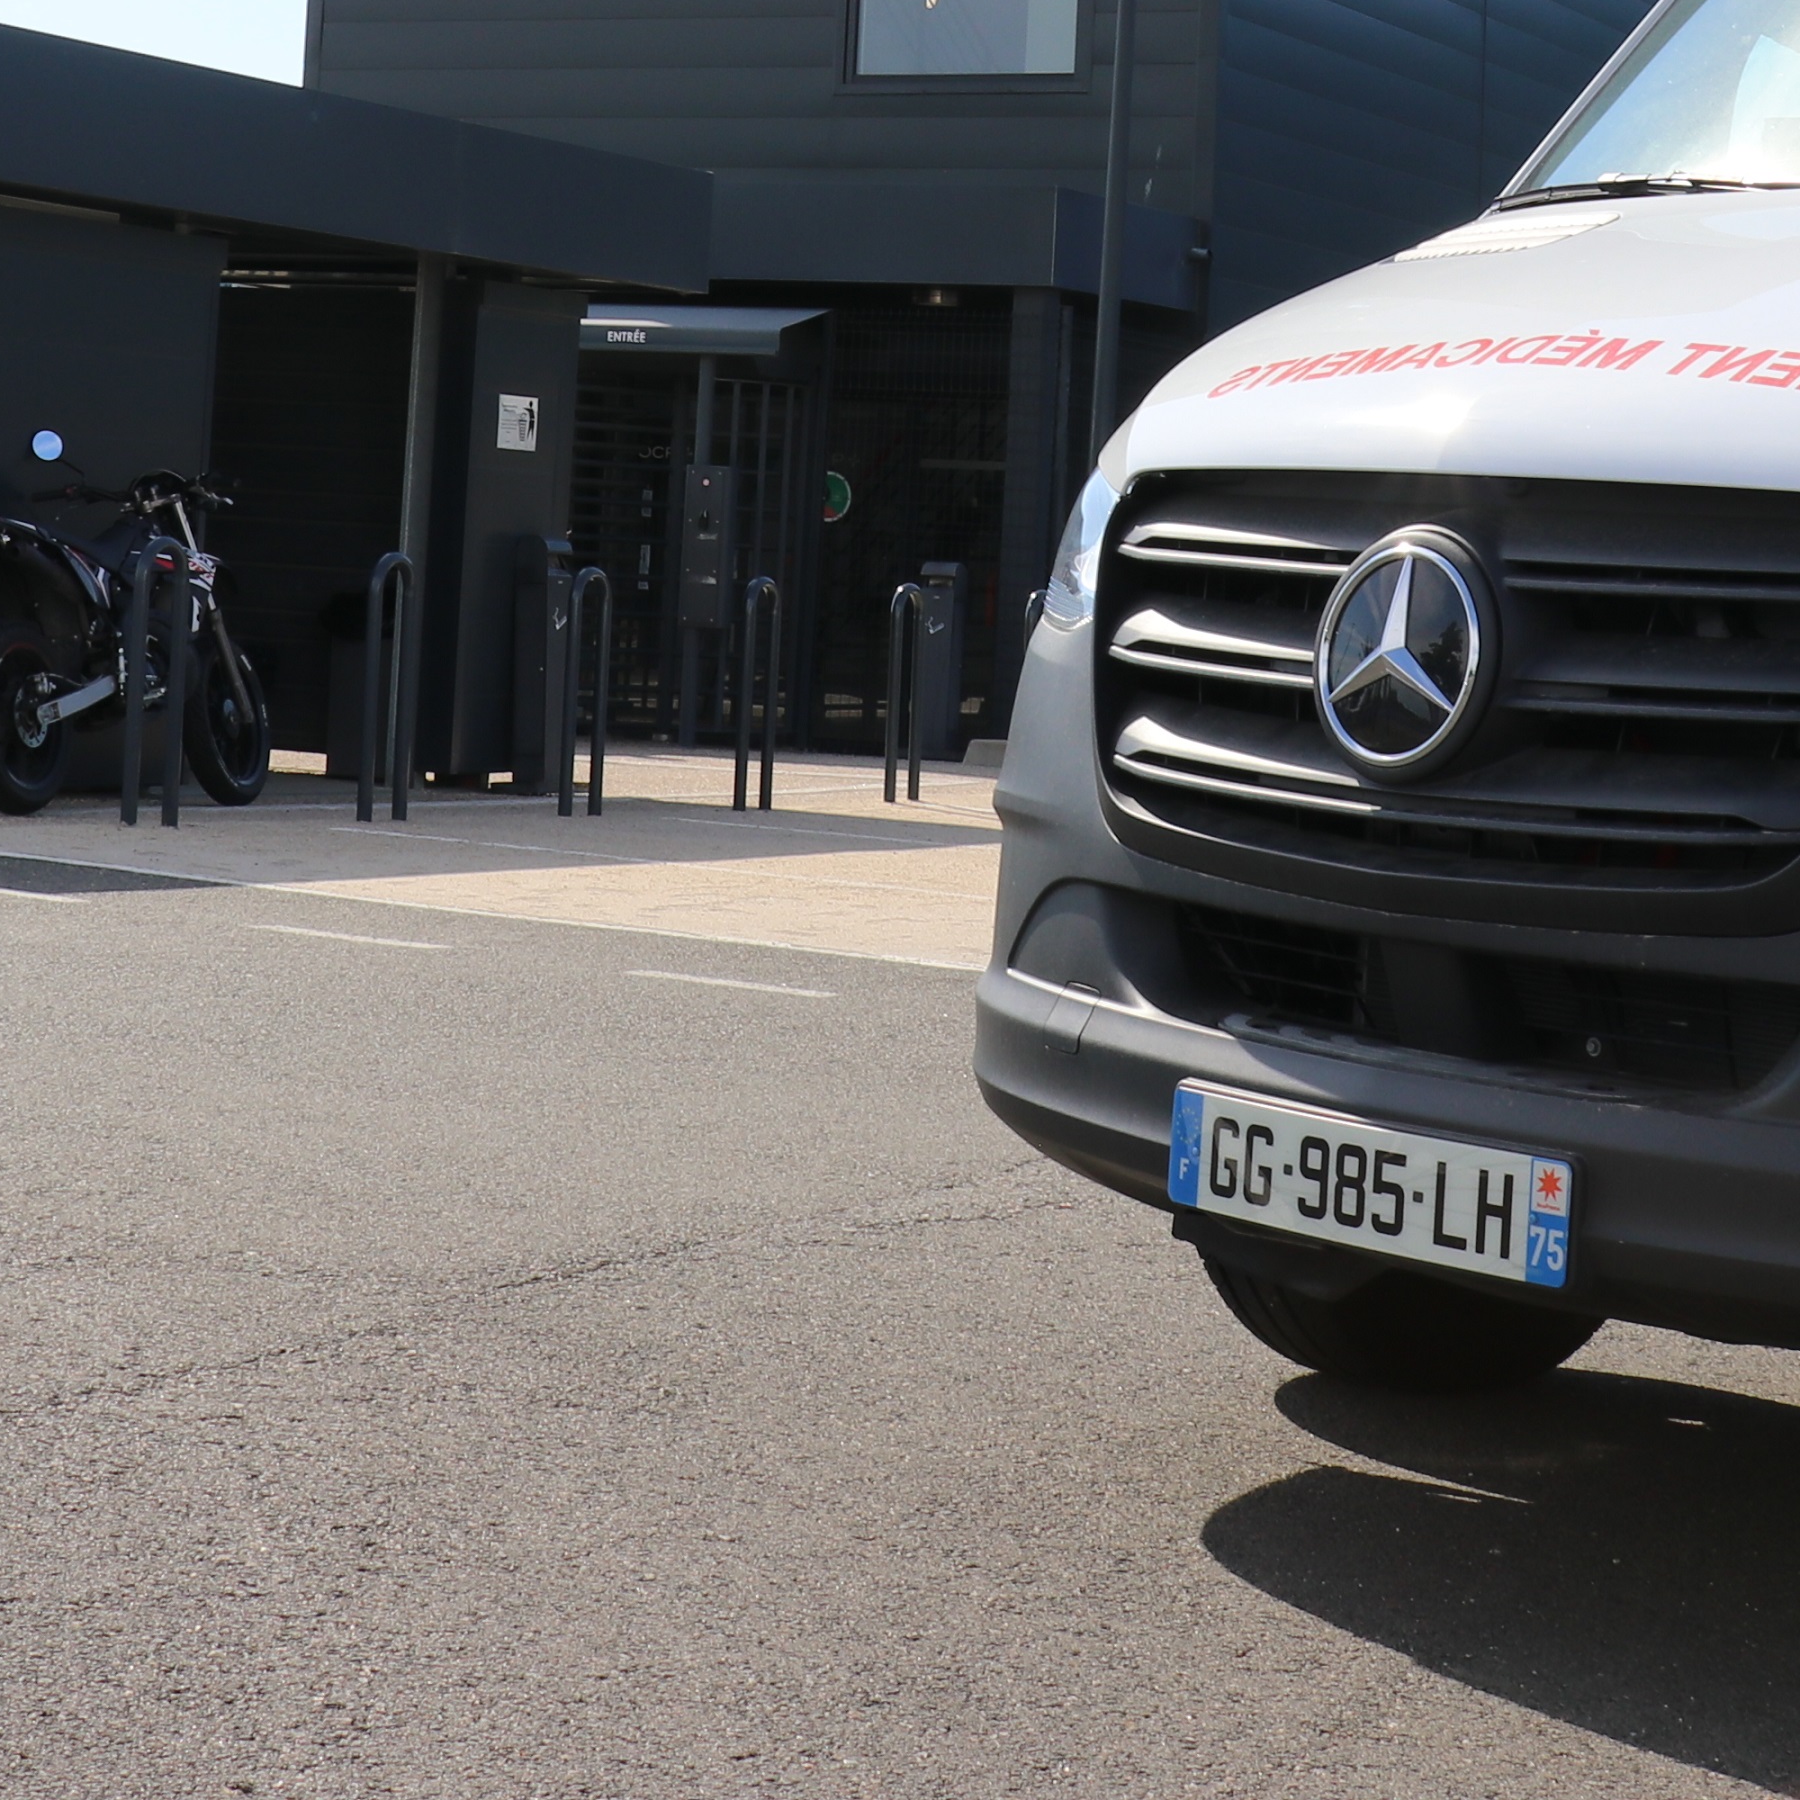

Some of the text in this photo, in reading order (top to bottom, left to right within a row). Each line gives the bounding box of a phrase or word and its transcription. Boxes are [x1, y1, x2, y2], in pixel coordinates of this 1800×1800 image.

[607, 328, 646, 343] ENTRÉE
[1178, 1157, 1190, 1180] F
[1529, 1224, 1564, 1272] 75
